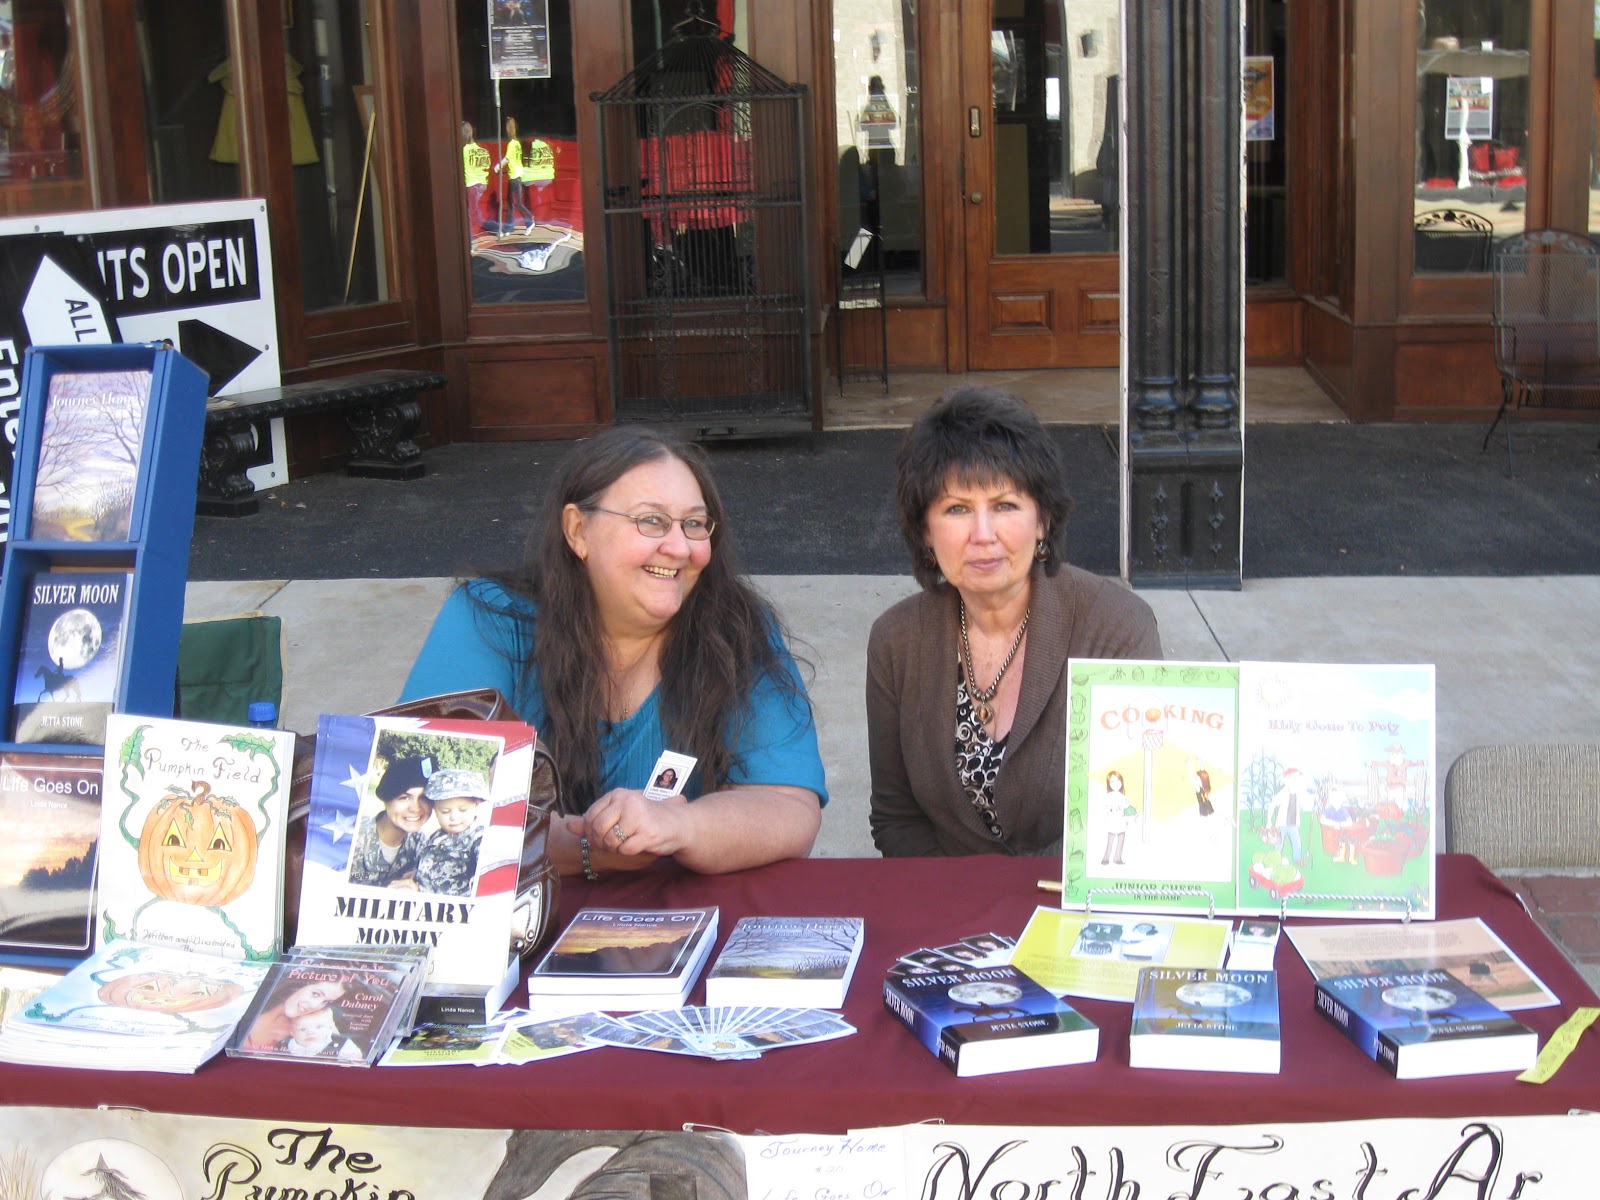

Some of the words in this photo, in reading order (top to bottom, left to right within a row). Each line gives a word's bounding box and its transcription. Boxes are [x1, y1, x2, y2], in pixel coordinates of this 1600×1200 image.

[162, 237, 247, 294] OPEN
[65, 299, 97, 342] ALL
[52, 393, 98, 409] Journey
[34, 584, 77, 604] SILVER
[79, 584, 120, 604] MOON
[40, 715, 61, 728] JETTA
[62, 715, 85, 728] STONE
[181, 737, 209, 752] The
[144, 747, 205, 778] Pumpkin
[212, 756, 262, 784] Field
[2, 775, 29, 792] Life
[34, 777, 73, 794] Goes
[76, 779, 99, 795] On
[334, 896, 476, 925] MILITARY
[355, 927, 443, 947] MOMMY
[287, 969, 338, 982] Picture
[340, 973, 359, 983] of
[364, 973, 390, 986] You
[902, 974, 962, 988] SILVER
[964, 968, 1017, 983] MOON
[1149, 969, 1208, 982] SILVER
[1215, 971, 1269, 984] MOON
[340, 999, 379, 1011] Dabney
[354, 992, 384, 1002] Carol
[267, 1127, 382, 1174] The
[760, 1138, 834, 1158] Journey
[840, 1137, 886, 1154] Home
[920, 1140, 1141, 1200] North
